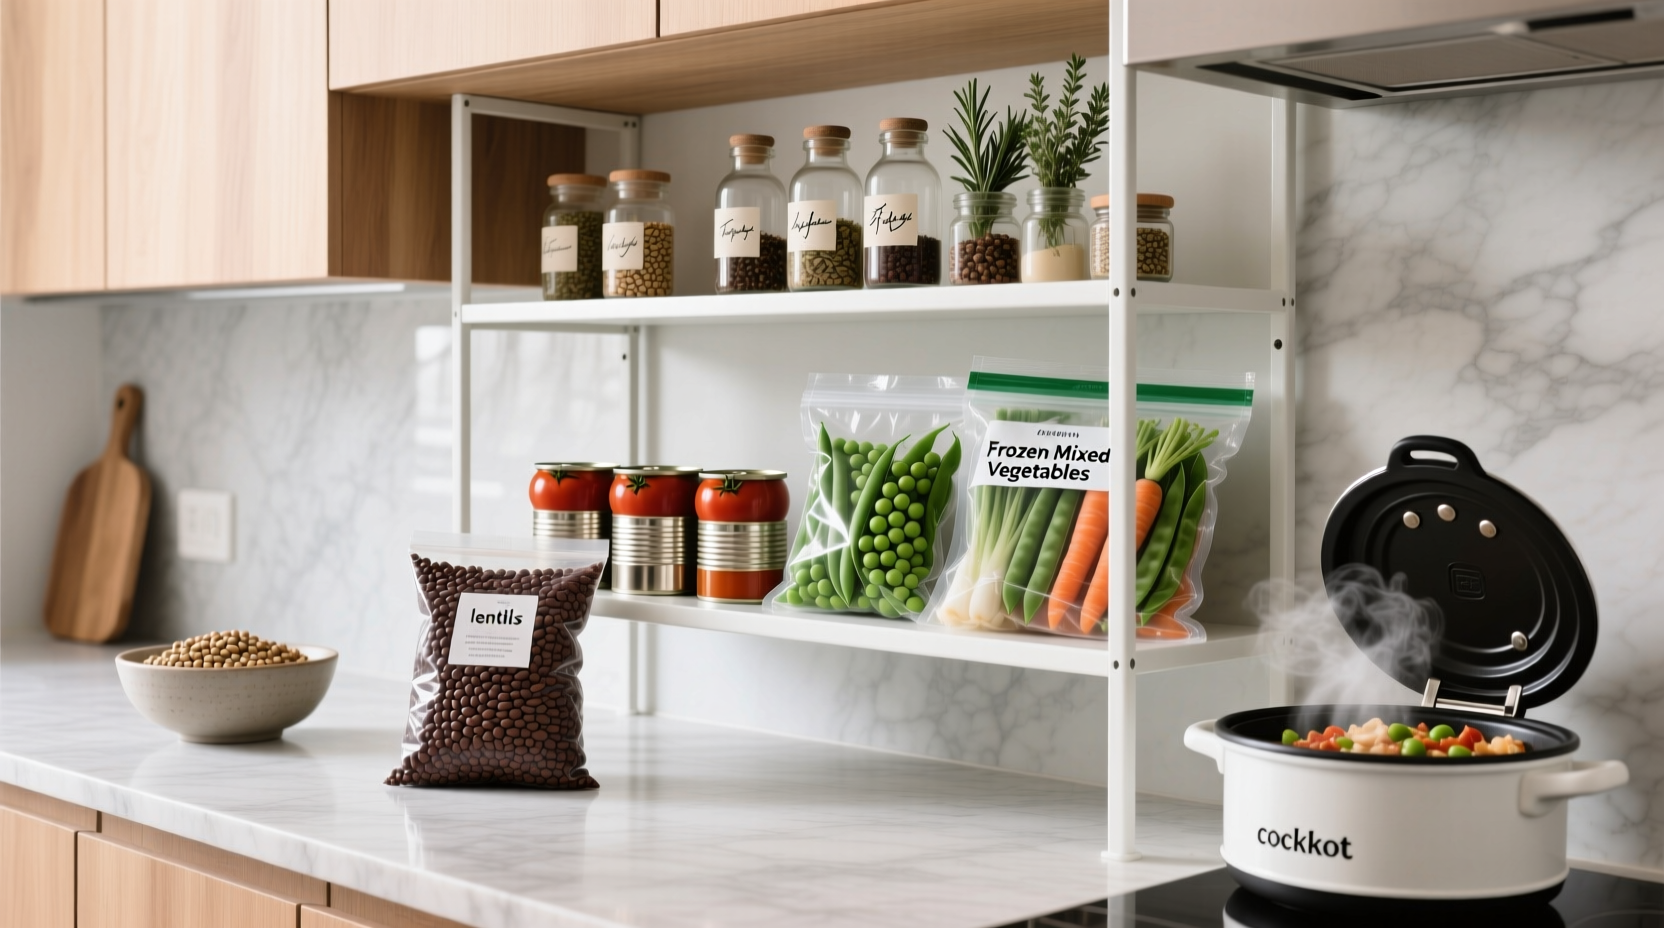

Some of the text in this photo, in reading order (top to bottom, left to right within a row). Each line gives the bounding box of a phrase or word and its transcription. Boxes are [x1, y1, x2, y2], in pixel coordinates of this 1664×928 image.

[987, 440, 1111, 463] Frozen Mixed
[988, 461, 1090, 482] Vegetables
[1257, 827, 1353, 860] cockkot
